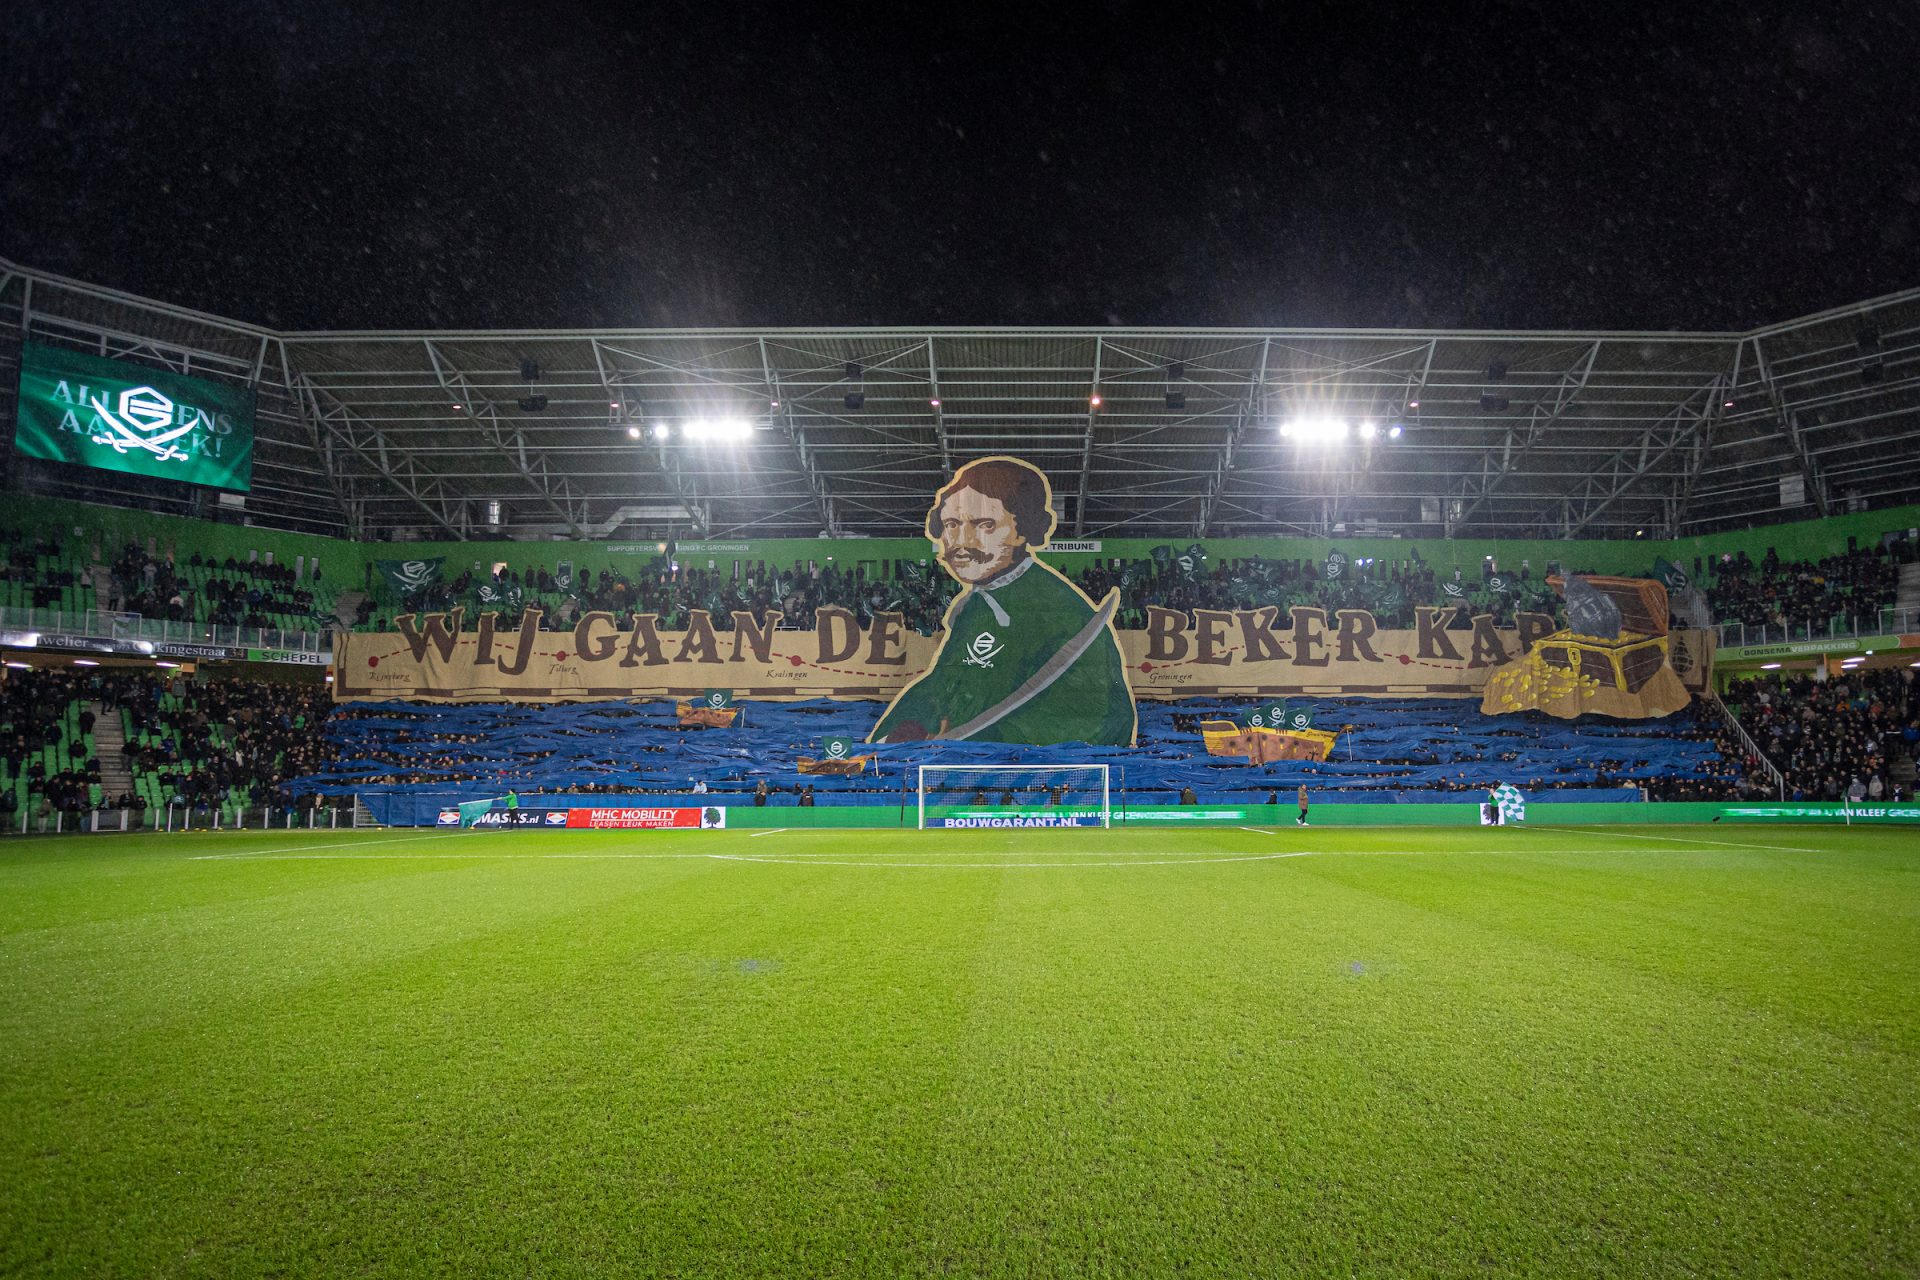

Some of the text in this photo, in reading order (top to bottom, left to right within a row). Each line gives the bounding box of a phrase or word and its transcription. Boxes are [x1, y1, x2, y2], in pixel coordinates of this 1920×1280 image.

[395, 606, 1557, 676] WIJ GAAN DE BEKER KAP
[261, 651, 323, 664] SCHEPEL
[766, 669, 808, 681] Kralingen
[1150, 672, 1193, 684] Groningen
[591, 809, 678, 819] MHC MOBILITY
[1856, 808, 1886, 817] KLEEF
[944, 818, 1082, 828] BOUWGARANT.NL
